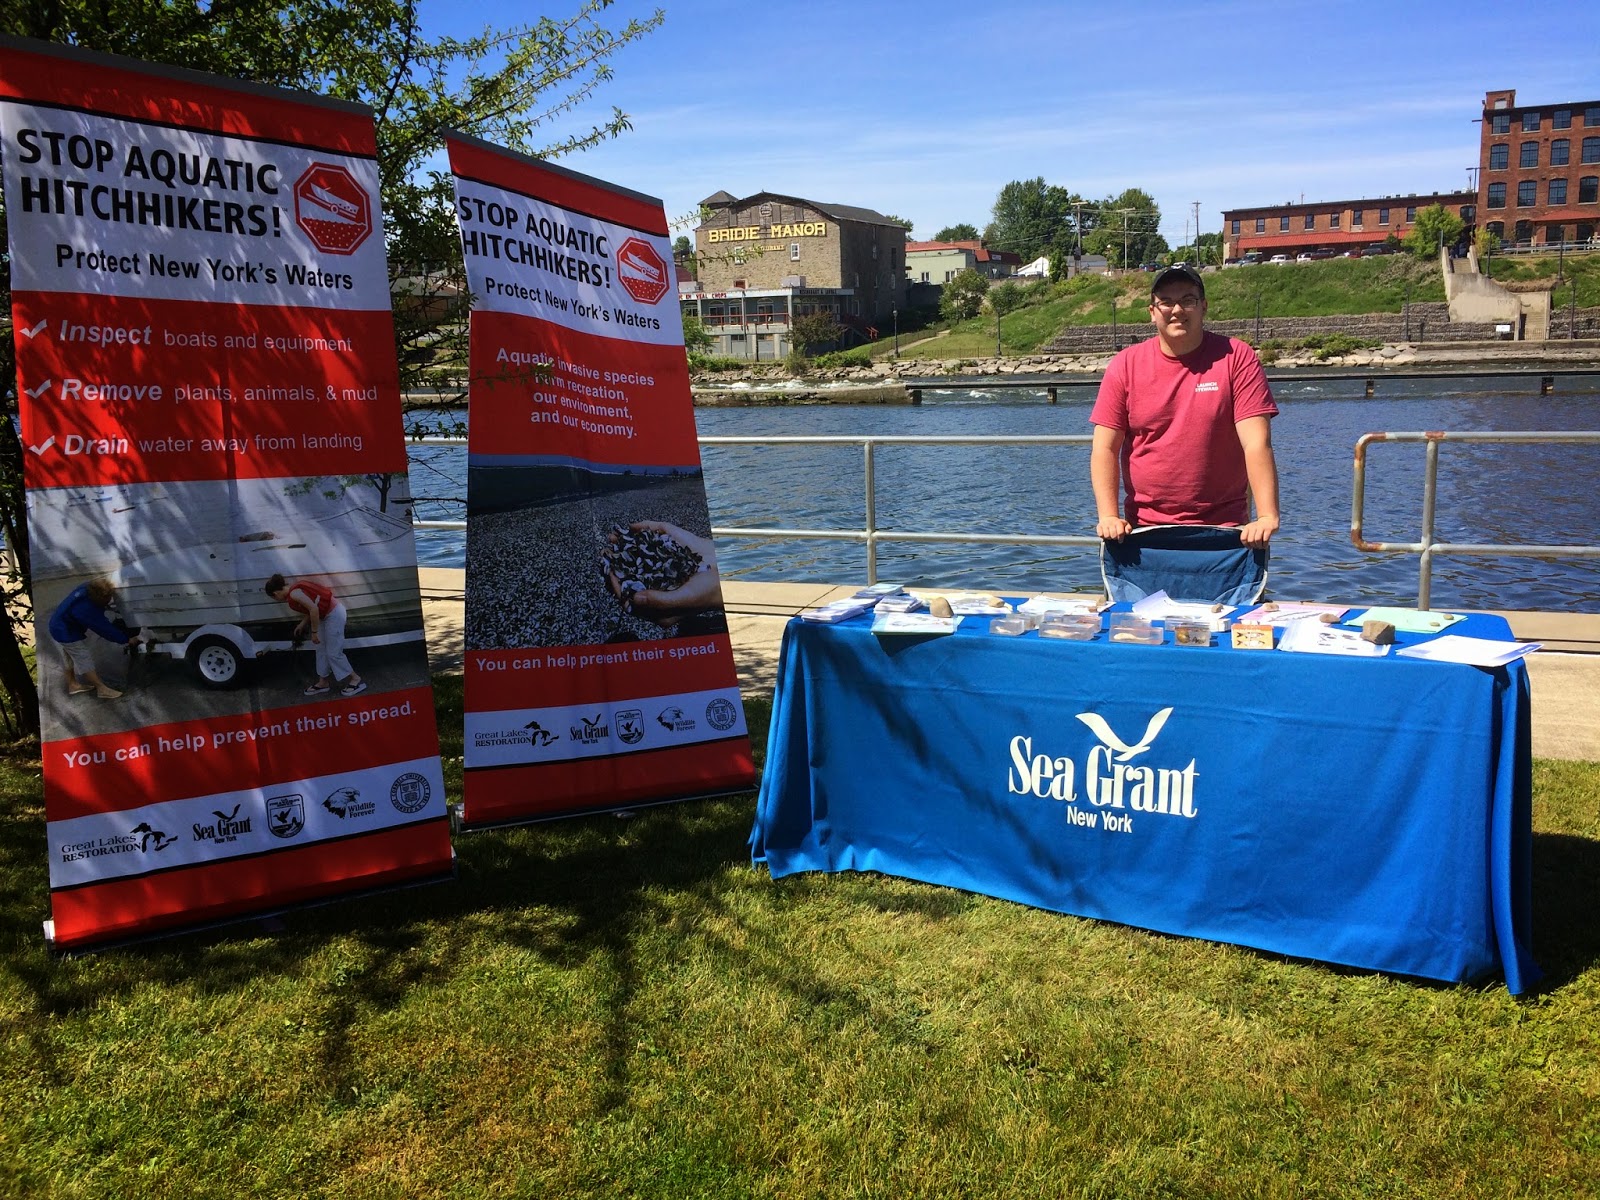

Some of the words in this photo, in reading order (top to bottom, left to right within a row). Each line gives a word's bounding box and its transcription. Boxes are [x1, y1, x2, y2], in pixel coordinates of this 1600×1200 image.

[16, 128, 113, 172] STOP
[124, 145, 279, 195] AQUATIC
[20, 176, 282, 238] HITCHHIKERS!
[459, 196, 518, 229] STOP
[525, 213, 609, 258] AQUATIC
[708, 226, 760, 243] BRIDIE
[770, 222, 827, 238] MANOR
[56, 244, 140, 275] Protect
[149, 254, 200, 279] New
[284, 264, 354, 290] Waters
[485, 277, 541, 302] Protect
[544, 289, 568, 312] New
[614, 308, 660, 330] Waters
[60, 319, 152, 346] Inspect
[164, 329, 218, 348] boats
[224, 333, 256, 351] and
[263, 335, 353, 354] equipment
[496, 347, 555, 367] Aquatic
[557, 356, 600, 380] invasive
[603, 370, 655, 386] species
[60, 379, 163, 401] Remove
[174, 385, 238, 404] plants,
[244, 385, 321, 403] animals,
[325, 386, 338, 401] &
[341, 385, 378, 402] mud
[567, 382, 629, 403] recreation,
[533, 391, 557, 405] our
[560, 396, 633, 421] environment,
[530, 410, 560, 423] and
[562, 415, 579, 428] our
[580, 420, 638, 439] economy.
[63, 435, 129, 456] Drain
[139, 438, 193, 453] water
[200, 438, 248, 455] away
[254, 435, 296, 451] from
[302, 433, 363, 453] landing
[475, 656, 507, 673] You
[512, 656, 542, 671] can
[546, 654, 577, 670] help
[579, 649, 630, 669] prevent
[631, 646, 666, 662] their
[668, 641, 721, 661] spread.
[63, 750, 107, 769] You
[114, 743, 152, 763] can
[157, 733, 207, 757] help
[212, 719, 292, 750] prevent
[296, 711, 342, 733] their
[347, 700, 418, 727] spread.
[474, 730, 500, 741] Great
[501, 729, 529, 738] Lakes
[475, 736, 533, 748] RESTORATION
[570, 726, 584, 742] Sea
[584, 724, 609, 739] Grant
[1008, 735, 1077, 801] Sea
[1085, 745, 1200, 818] Grant
[347, 801, 376, 813] Wildlife
[349, 808, 376, 819] Forever
[1066, 805, 1099, 829] New
[1100, 810, 1133, 834] York
[192, 823, 215, 842] Sea
[217, 816, 253, 837] Grant
[214, 837, 225, 845] New
[61, 840, 96, 854] Great
[98, 834, 137, 848] Lakes
[62, 842, 141, 863] RESTORATION
